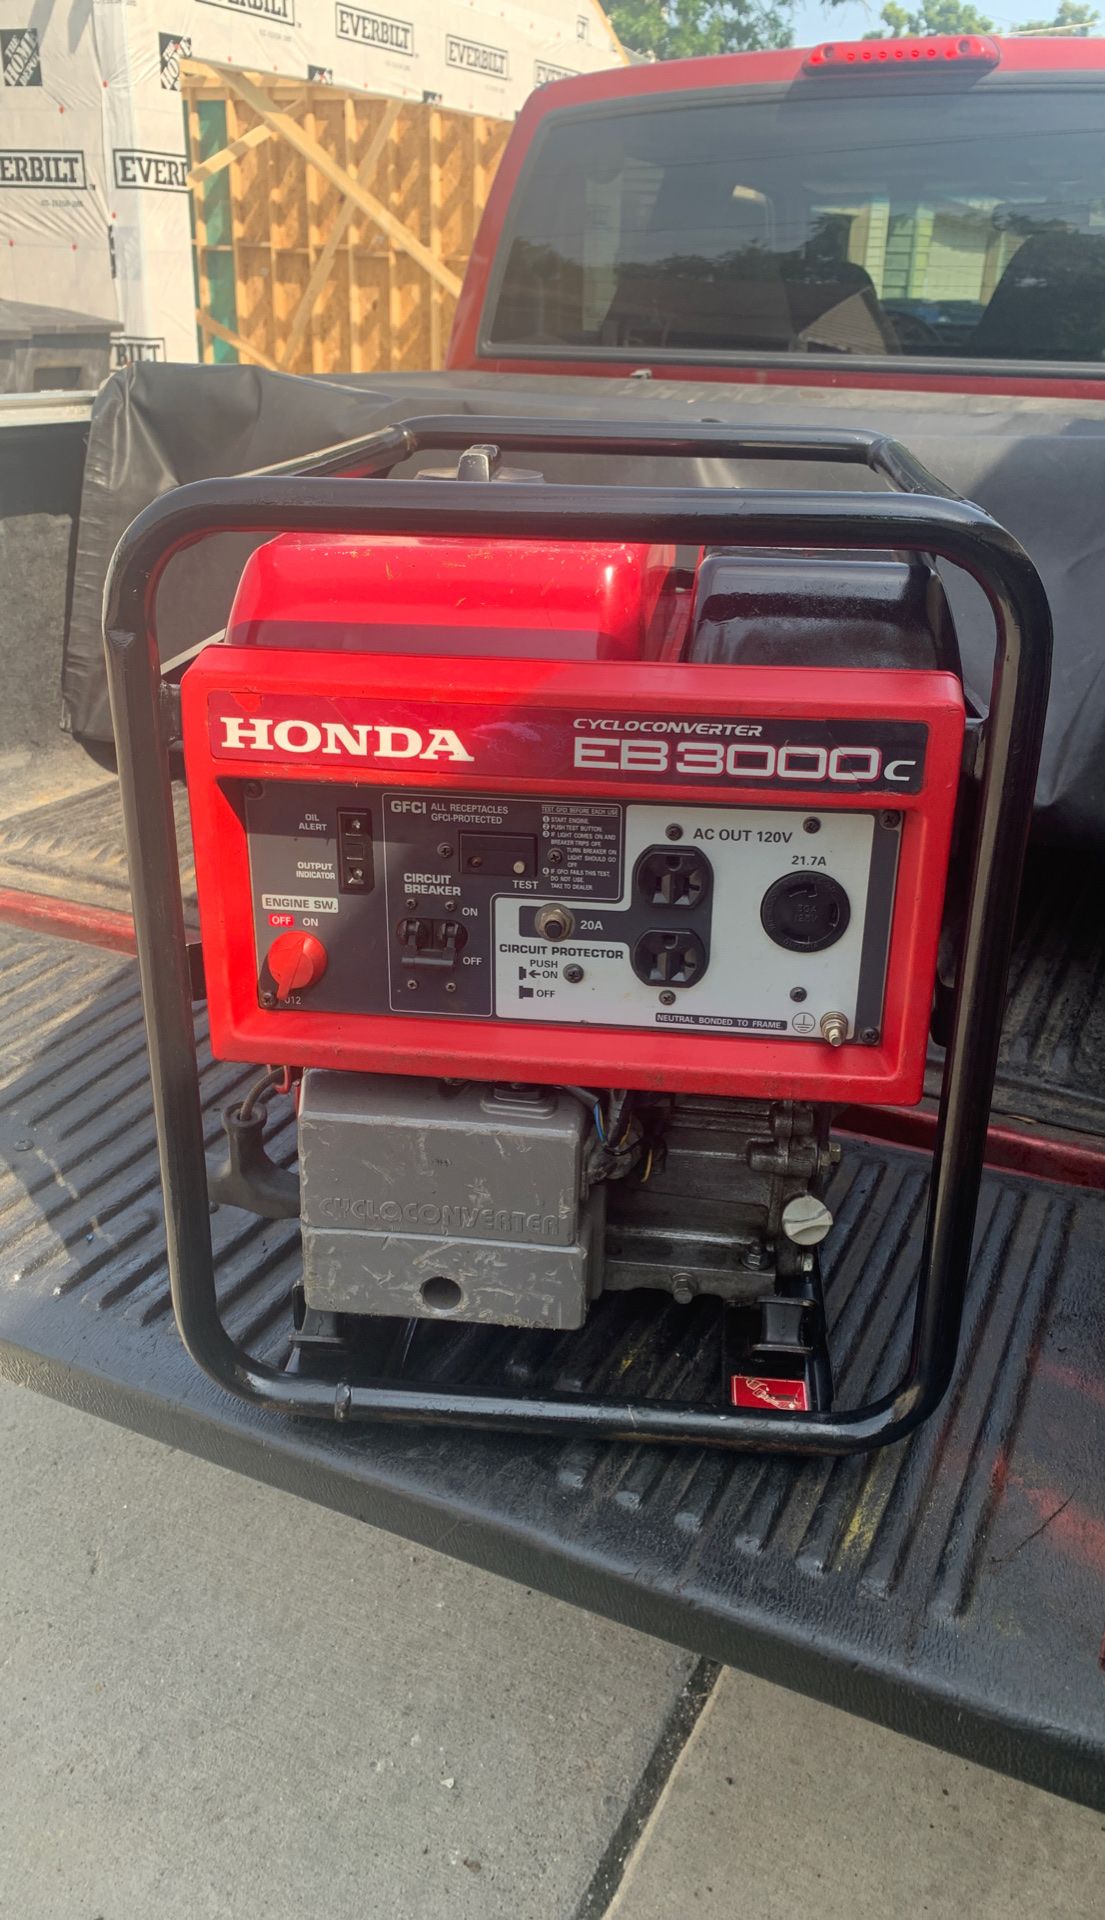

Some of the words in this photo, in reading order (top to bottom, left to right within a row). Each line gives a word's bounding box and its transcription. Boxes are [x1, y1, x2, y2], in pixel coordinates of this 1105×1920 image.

[339, 10, 410, 49] EVERBILT
[449, 41, 506, 74] EVERBILT
[573, 718, 763, 737] CYCLOCONVERTER
[220, 717, 475, 762] HONDA
[390, 800, 427, 814] GFCI
[431, 803, 447, 811] ALL
[450, 804, 508, 815] RECEPTACLES
[304, 814, 320, 822] OIL
[431, 813, 503, 825] GFCI-PROTECTED
[298, 822, 327, 831] ALERT
[693, 828, 715, 841] AC
[719, 829, 752, 841] OUT
[757, 831, 793, 843] 120V
[297, 861, 333, 871] OUTPUT
[791, 855, 827, 866] 21.7A
[296, 871, 336, 880] INDICATOR
[403, 873, 452, 885] CIRCUIT
[512, 880, 538, 889] TEST
[404, 885, 461, 896] BREAKER
[265, 898, 310, 909] ENGINE
[314, 900, 337, 910] SW.
[462, 908, 478, 916] ON
[271, 916, 291, 925] OFF
[302, 918, 319, 927] ON
[580, 921, 604, 930] 20A
[499, 944, 547, 955] CIRCUIT
[551, 946, 624, 959] PROTECTOR
[462, 957, 482, 966] OFF
[529, 960, 558, 968] PUSH
[542, 970, 558, 979] ON
[536, 989, 556, 998] OFF
[657, 1014, 695, 1024] NEUTRAL
[698, 1016, 733, 1026] BONDED
[737, 1018, 749, 1027] TO
[318, 1197, 560, 1236] CYCLOCONVERTER
